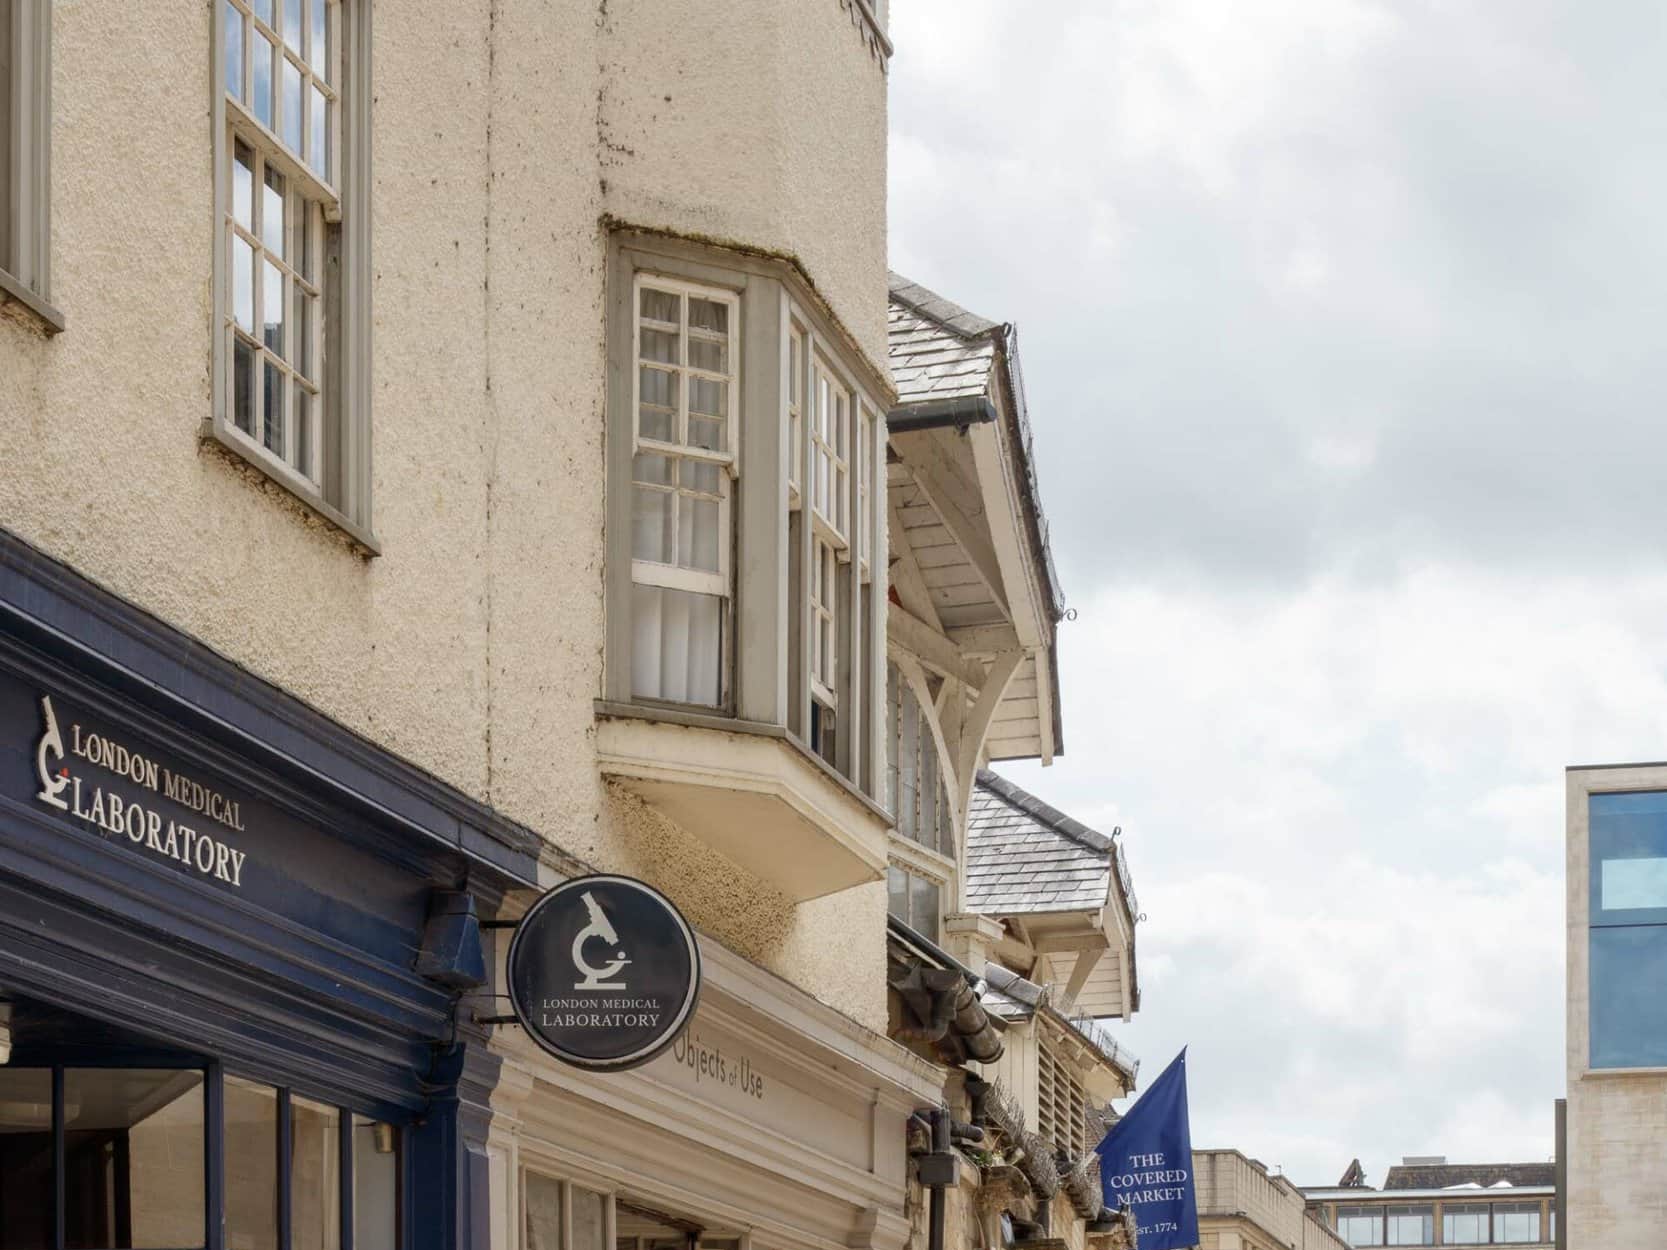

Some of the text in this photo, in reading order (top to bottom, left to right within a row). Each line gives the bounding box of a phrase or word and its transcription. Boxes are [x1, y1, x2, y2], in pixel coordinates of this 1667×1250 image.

[71, 724, 245, 832] LONDON MEDICAL
[71, 776, 246, 886] LABORATORY
[543, 999, 660, 1009] LONDON MEDICAL
[542, 1013, 660, 1027] LABORATORY
[673, 1023, 762, 1099] Objects of Use
[1129, 1153, 1165, 1168] THE
[1110, 1170, 1187, 1188] COVERED
[1117, 1187, 1184, 1206] MARKET
[1155, 1222, 1178, 1233] 1774
